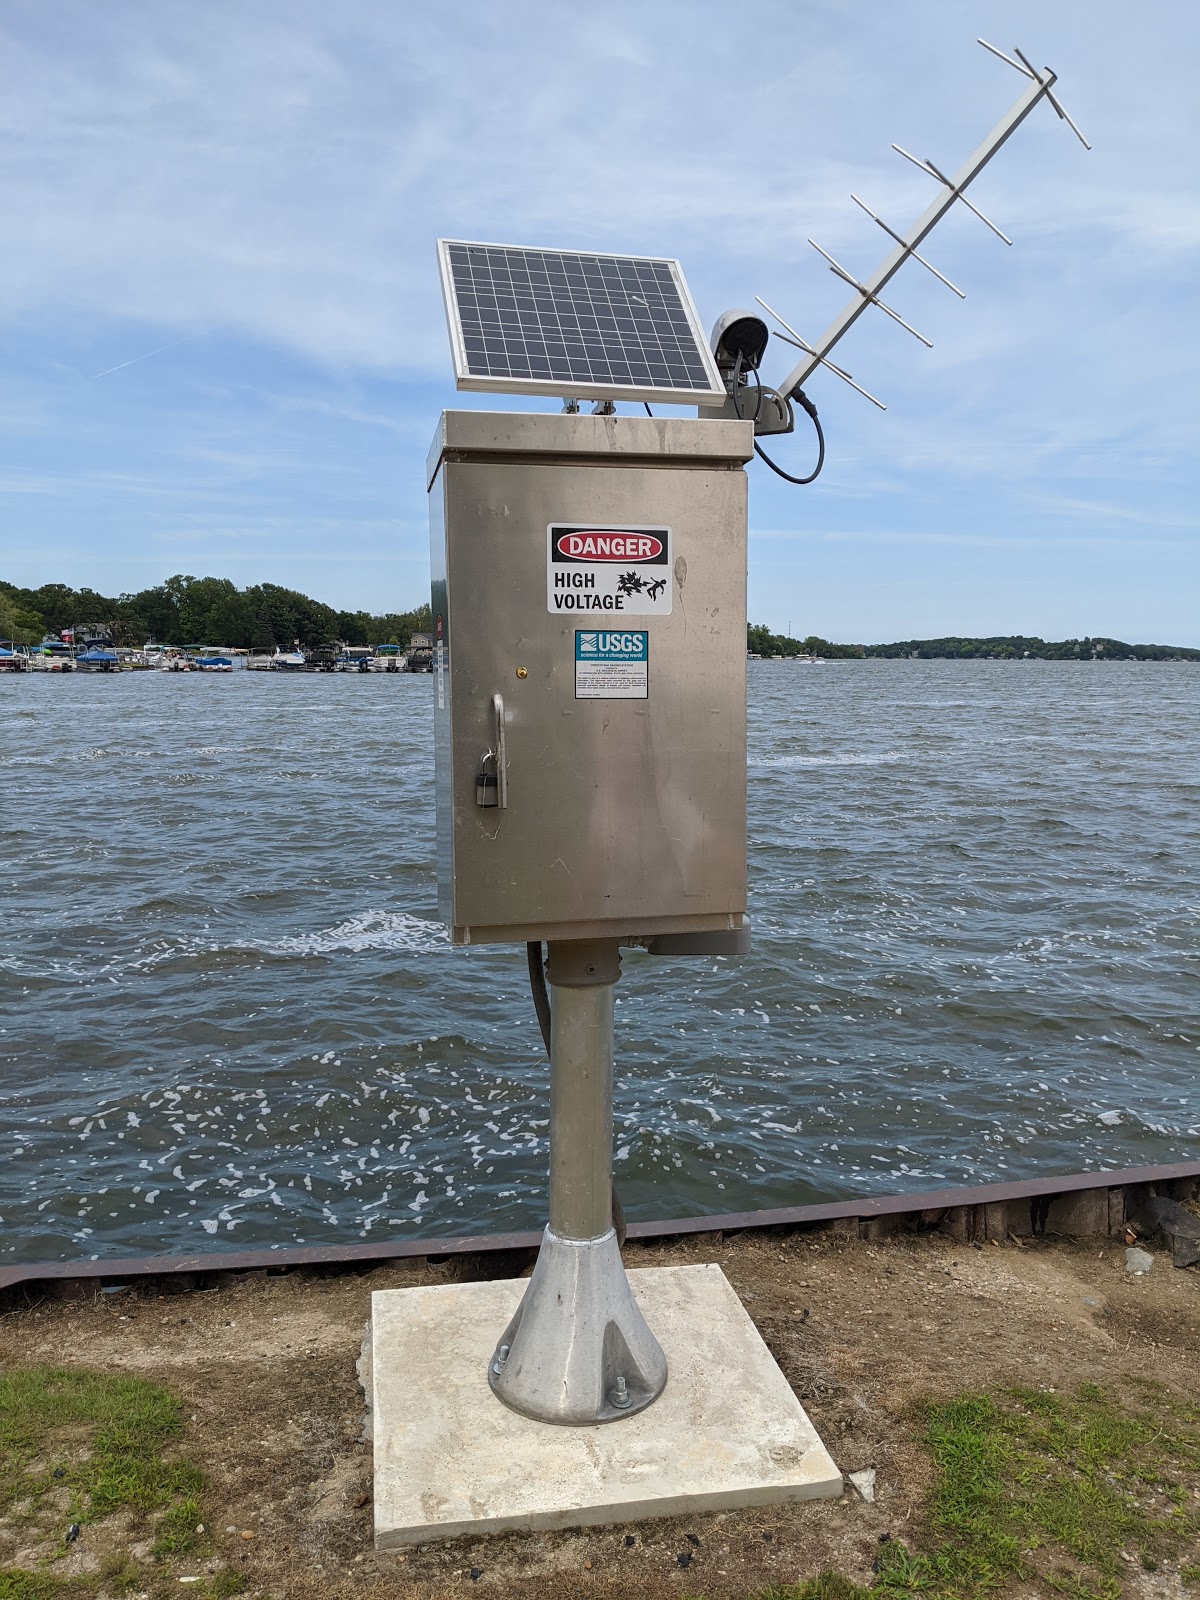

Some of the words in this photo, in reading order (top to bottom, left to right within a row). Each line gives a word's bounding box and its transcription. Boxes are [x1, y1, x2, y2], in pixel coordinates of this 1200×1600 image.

[569, 537, 652, 556] DANGER
[554, 572, 595, 588] HIGH
[553, 593, 624, 610] VOLTAGE
[598, 633, 644, 652] USGS
